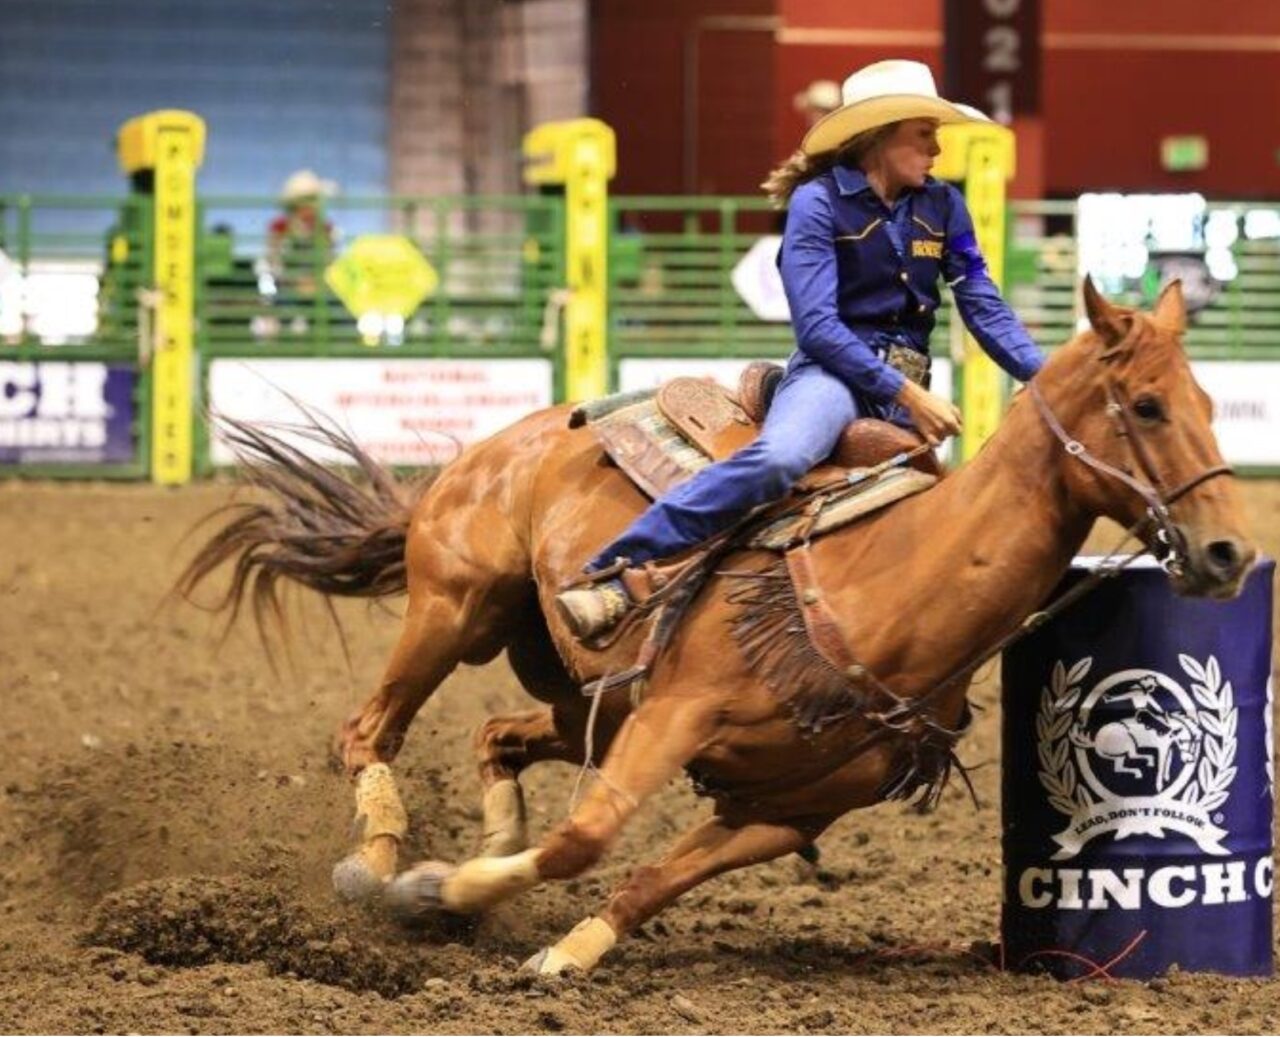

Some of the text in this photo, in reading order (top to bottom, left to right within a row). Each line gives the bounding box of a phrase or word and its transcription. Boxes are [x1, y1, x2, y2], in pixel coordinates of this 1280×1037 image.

[1074, 808, 1206, 834] LEAD, DON'T FOLLOW
[1019, 861, 1246, 910] CINCH
